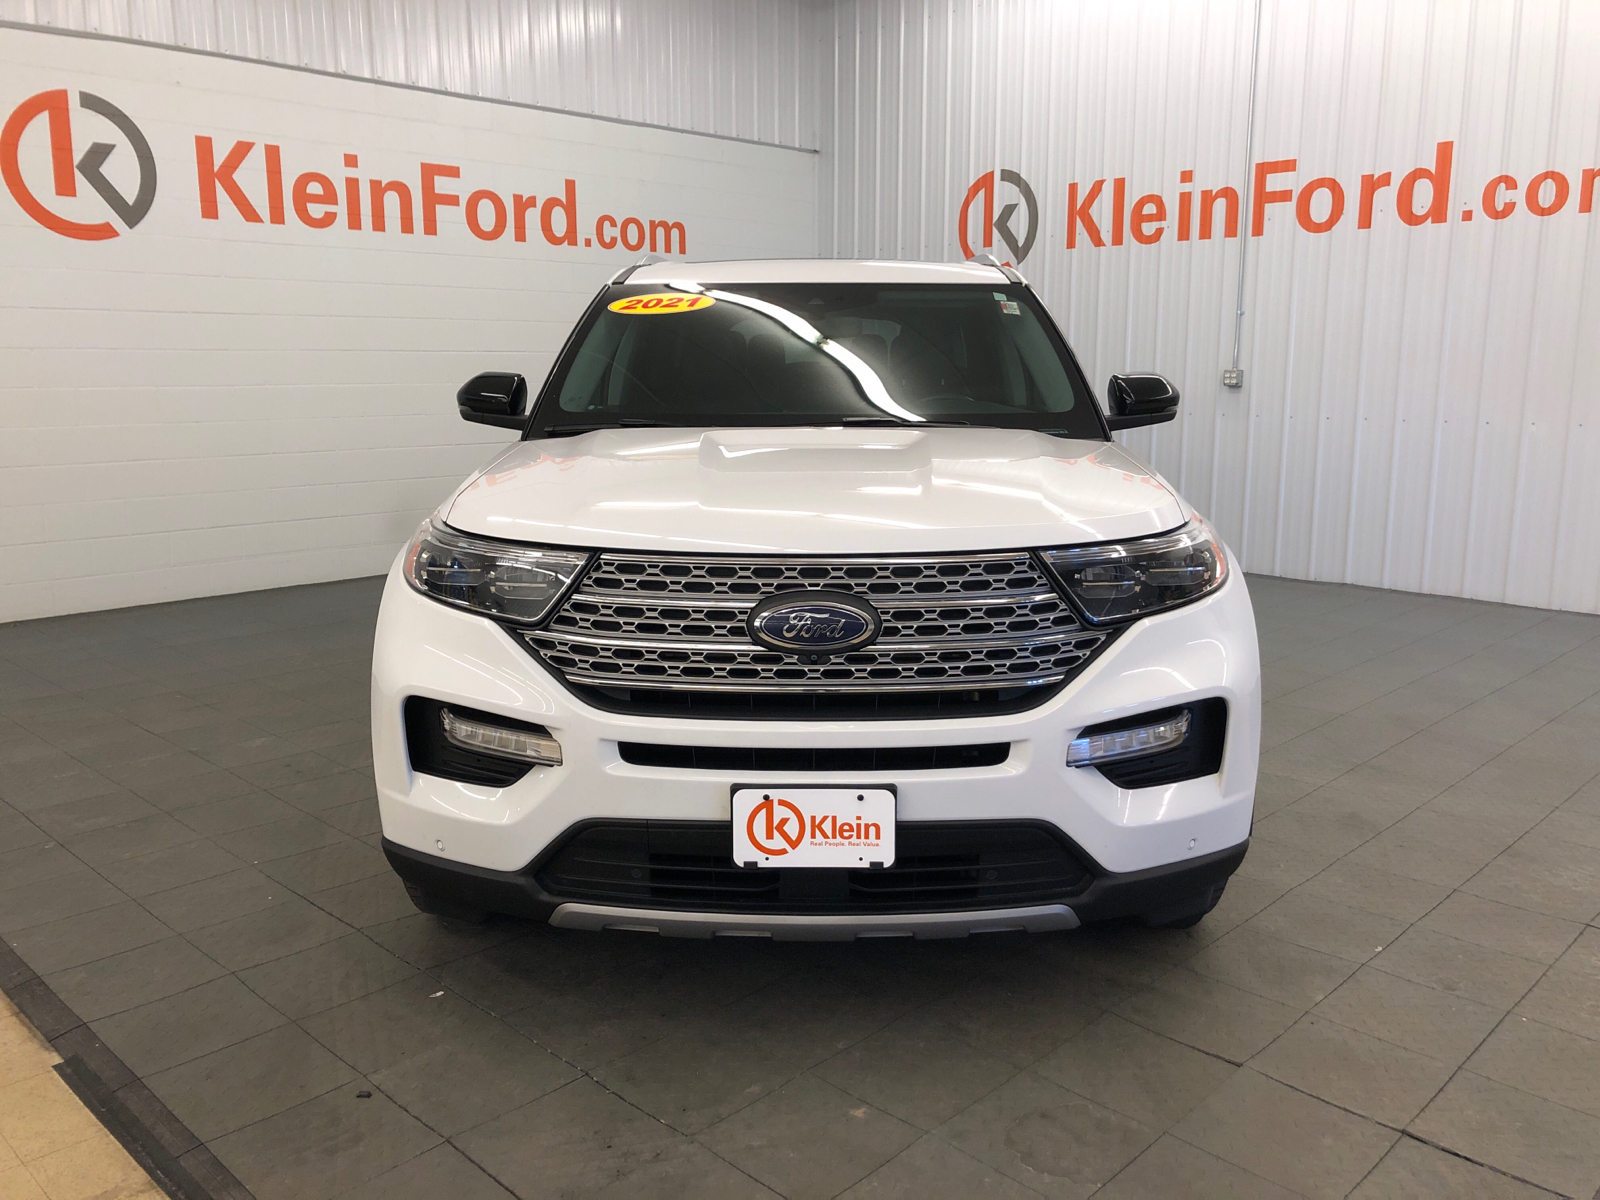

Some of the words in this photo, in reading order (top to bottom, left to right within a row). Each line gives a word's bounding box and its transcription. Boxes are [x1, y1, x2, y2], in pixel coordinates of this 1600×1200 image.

[194, 134, 687, 255] KleinFord.com
[618, 296, 703, 310] 2021
[783, 611, 846, 638] Ford
[810, 815, 881, 840] Klein
